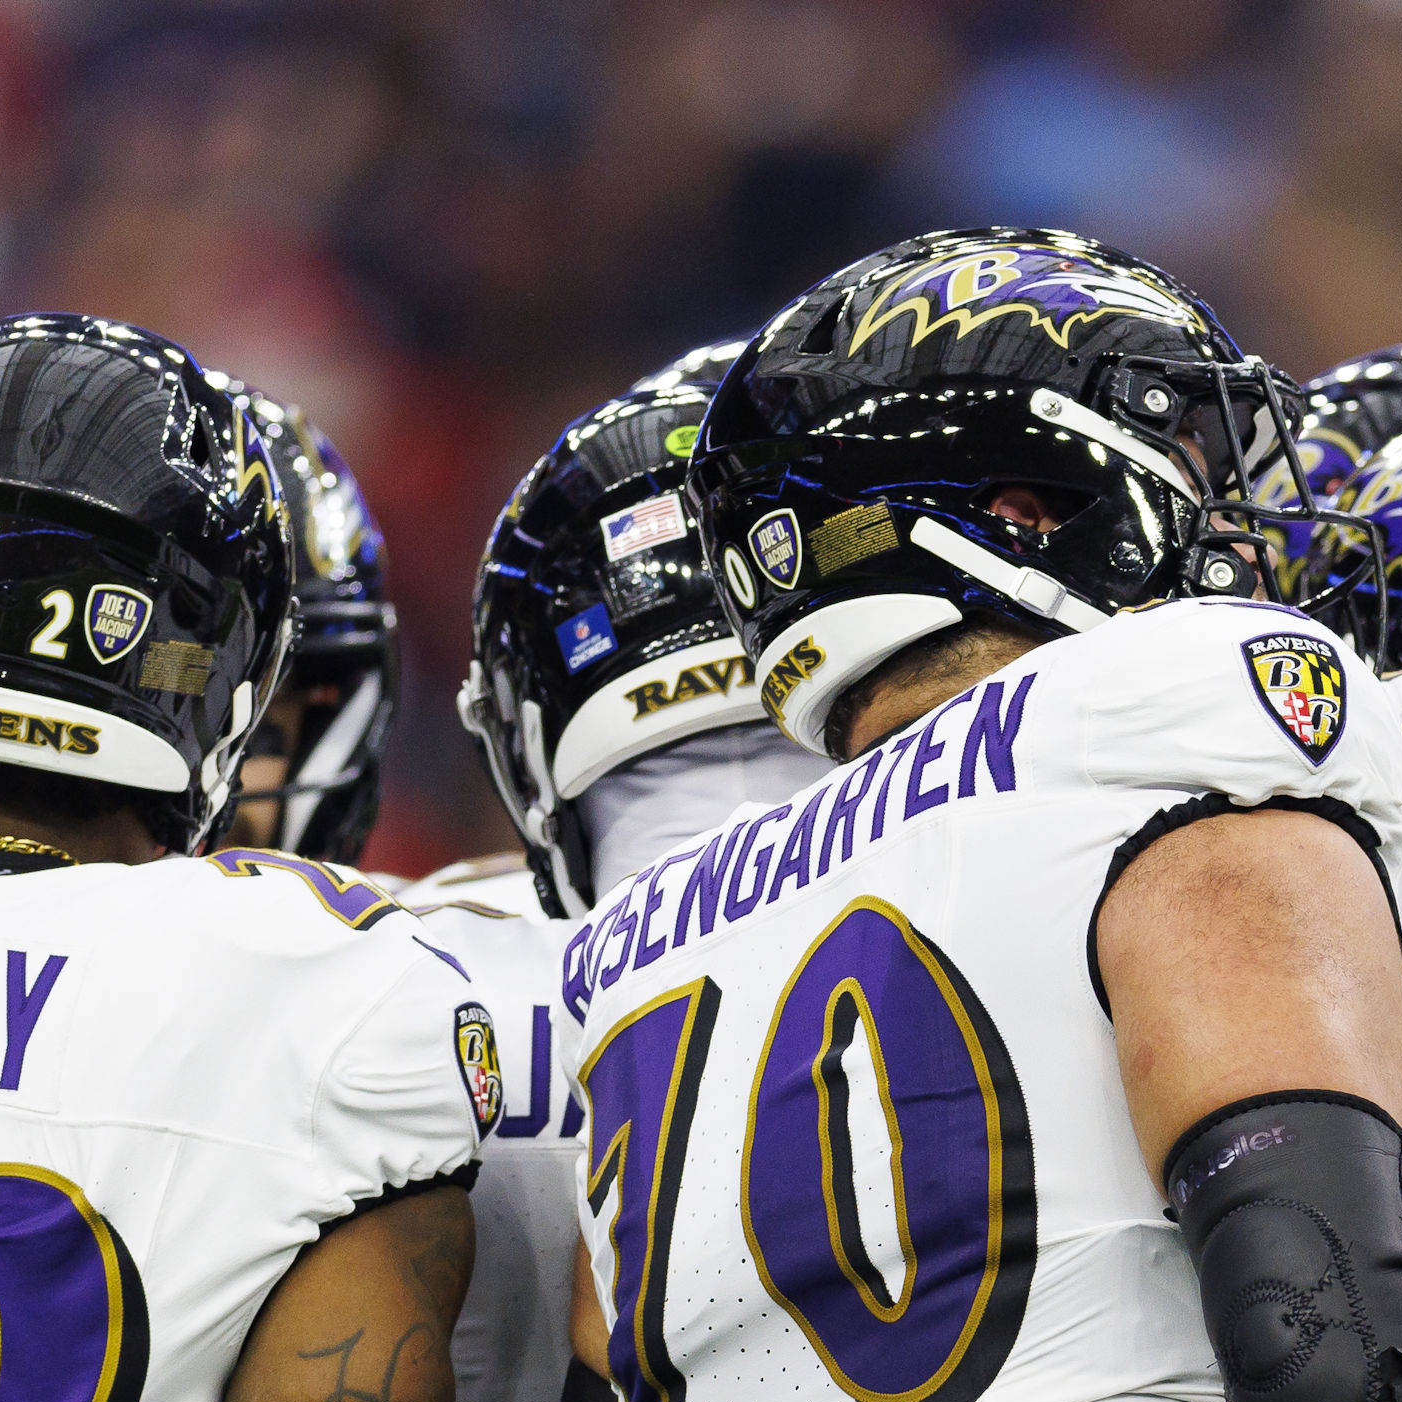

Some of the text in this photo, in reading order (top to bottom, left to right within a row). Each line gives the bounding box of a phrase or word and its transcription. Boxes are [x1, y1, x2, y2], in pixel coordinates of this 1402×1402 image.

[823, 504, 865, 525] WARNING
[757, 519, 789, 552] JOE D.
[764, 540, 795, 570] JACOBY
[98, 593, 138, 622] JOE D.
[30, 589, 75, 660] 2
[93, 616, 136, 640] JACOBY
[104, 636, 115, 650] 12
[1248, 636, 1332, 657] RAVENS
[623, 655, 756, 721] RAV
[562, 672, 1039, 1029] ROSENGARTEN
